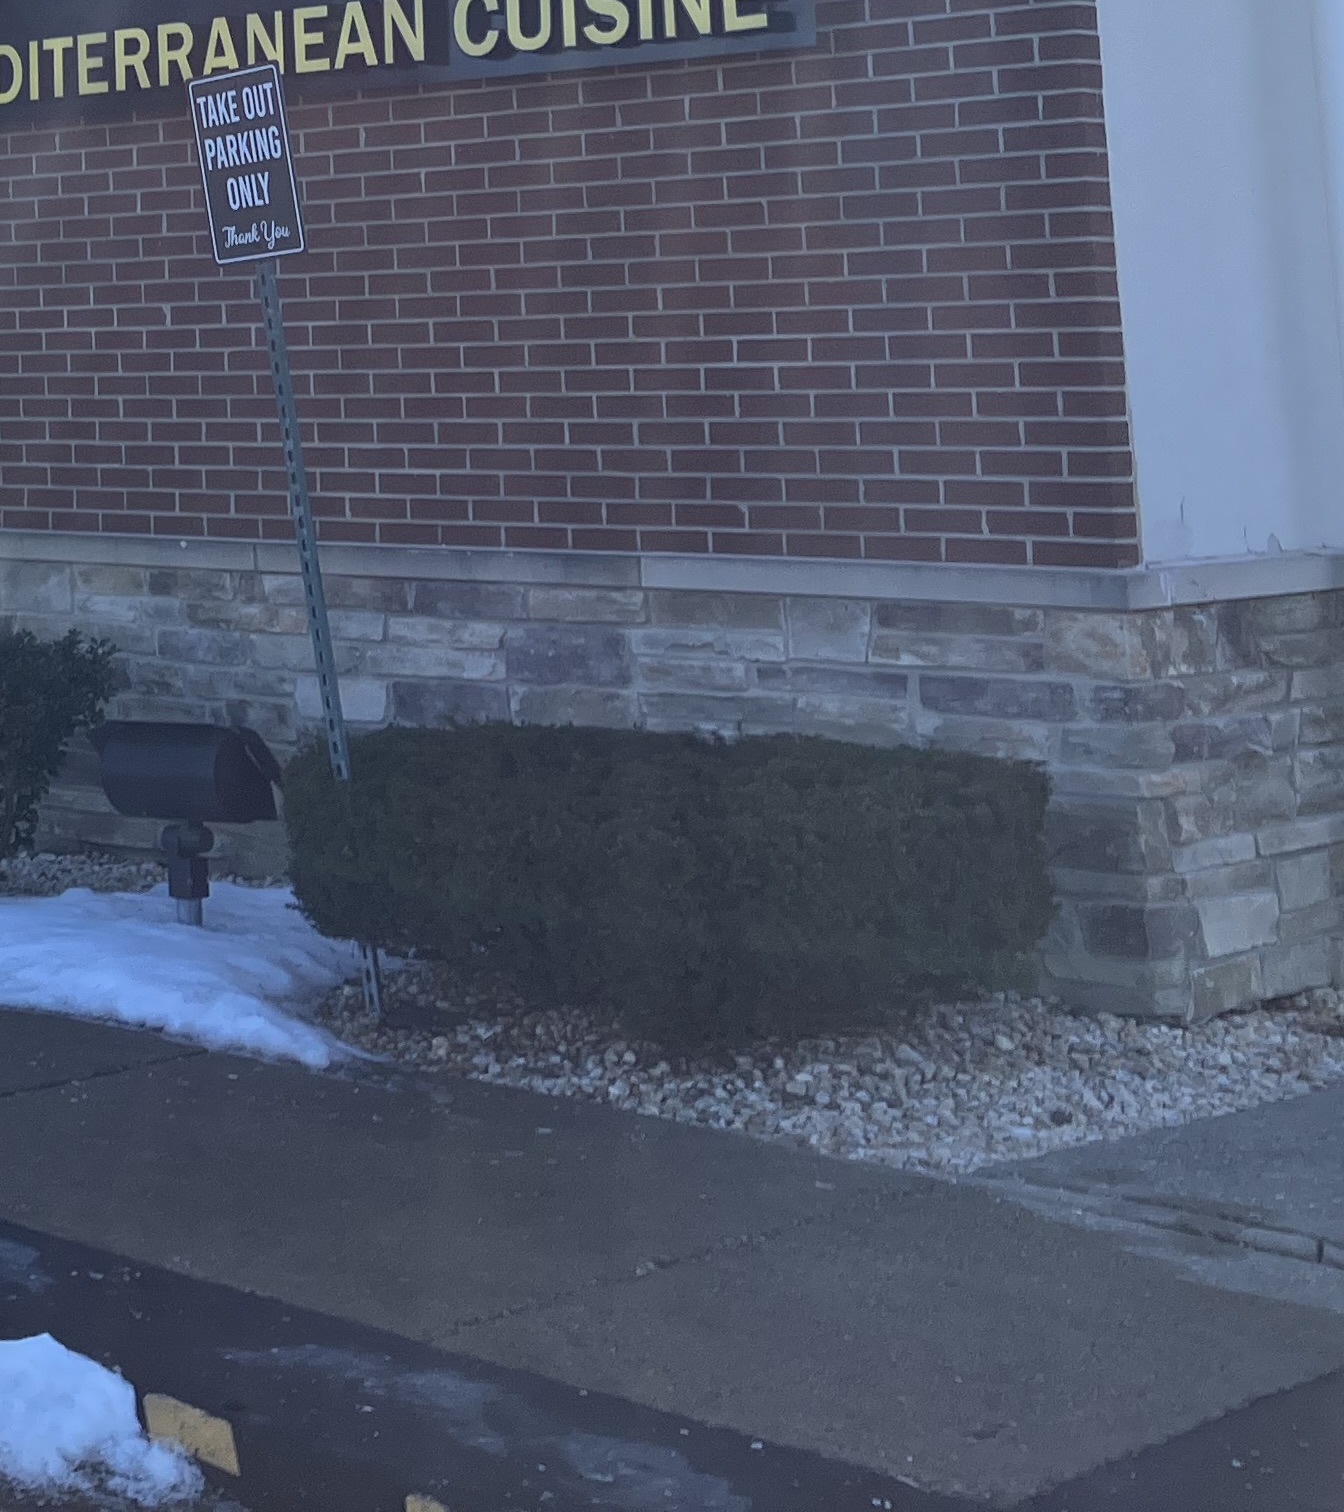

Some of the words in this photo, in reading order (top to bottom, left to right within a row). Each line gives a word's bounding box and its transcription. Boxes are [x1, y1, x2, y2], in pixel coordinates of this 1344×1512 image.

[196, 90, 240, 129] TAKE
[242, 82, 275, 120] OUT
[204, 125, 282, 171] PARKING
[226, 171, 271, 211] ONLY
[221, 222, 260, 249] Thank
[260, 219, 290, 250] You
